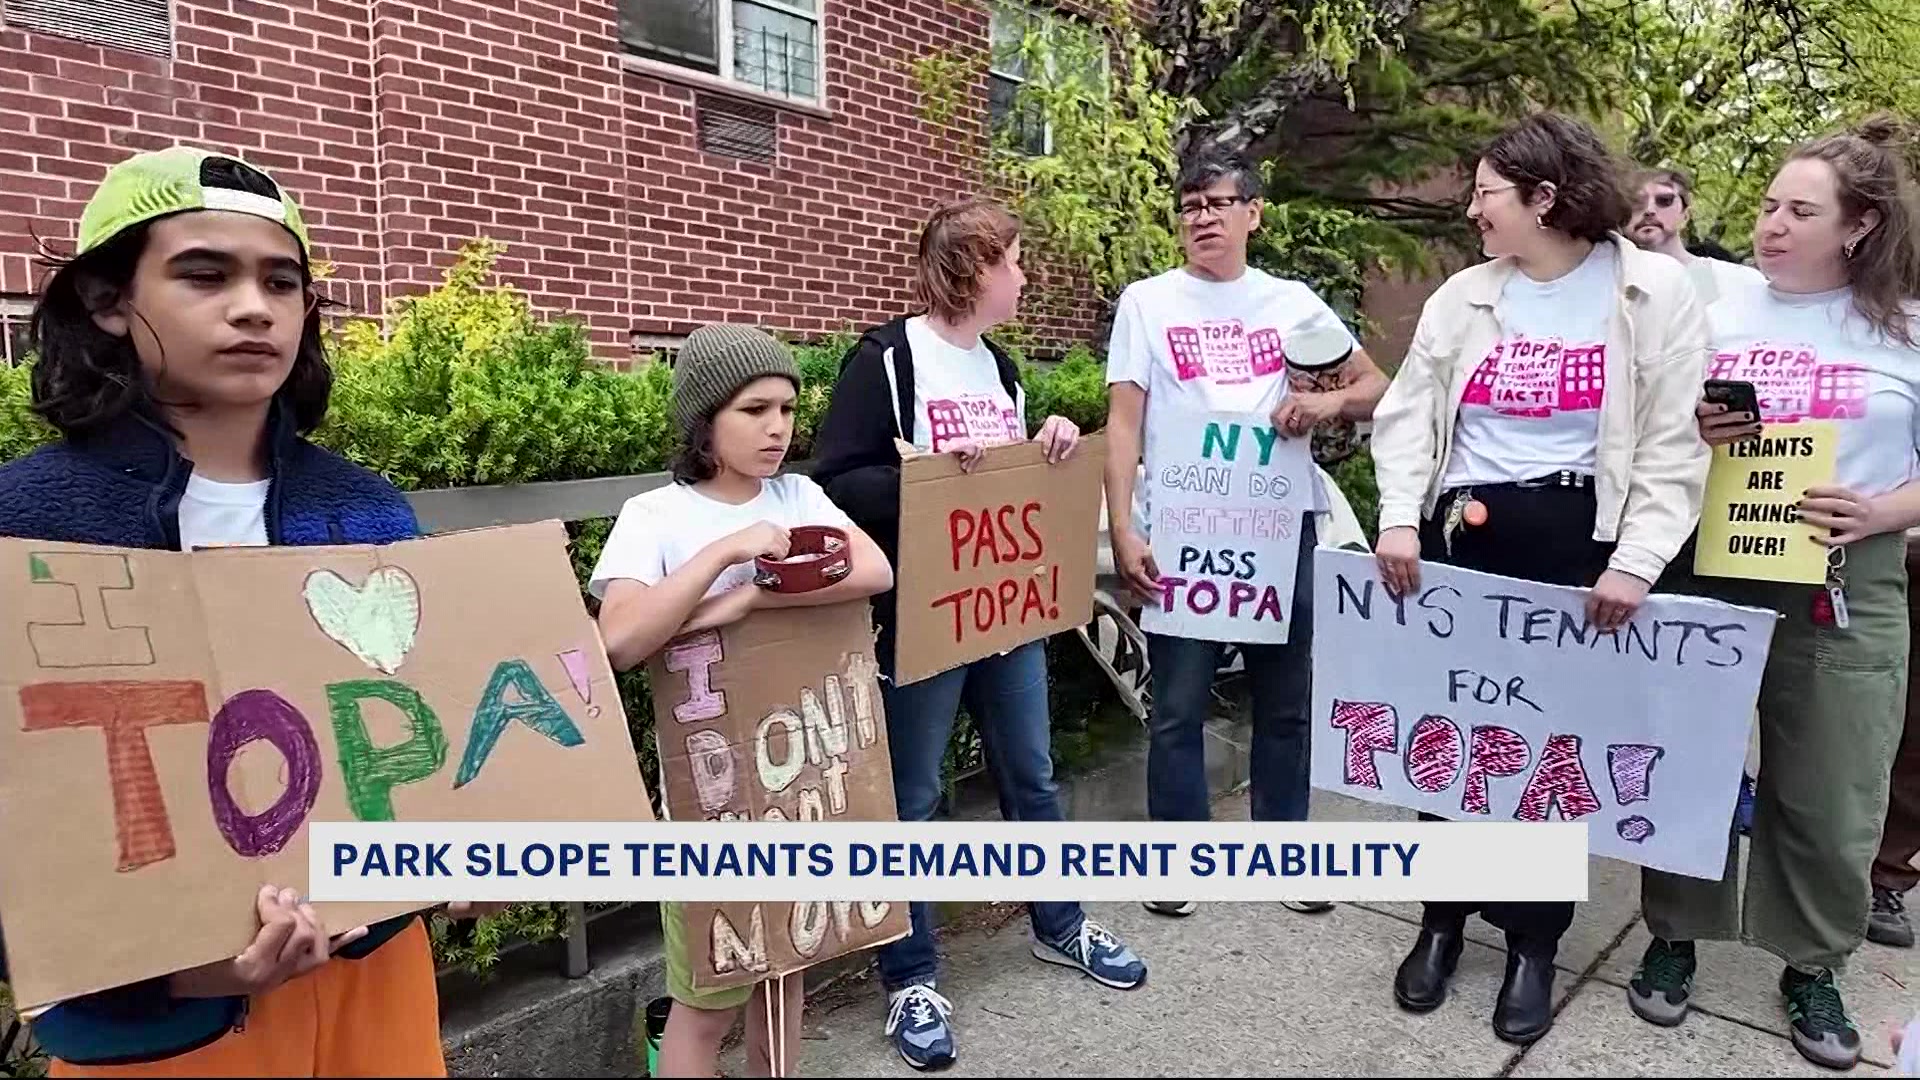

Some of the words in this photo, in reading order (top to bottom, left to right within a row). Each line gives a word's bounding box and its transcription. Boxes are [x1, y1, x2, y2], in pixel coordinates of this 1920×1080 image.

[1203, 324, 1243, 340] TOPA
[1509, 341, 1561, 358] TOPA
[1504, 359, 1556, 373] TENANT
[1750, 349, 1815, 367] TOPA
[961, 399, 998, 417] TOPA
[1202, 423, 1278, 466] NY
[1728, 436, 1814, 458] TENANTS
[1161, 463, 1232, 496] CAN
[1249, 472, 1292, 500] DO
[1746, 470, 1785, 490] ARE
[1160, 507, 1294, 541] BETTER
[1728, 502, 1797, 524] TAKING
[949, 502, 1043, 572] PASS
[1728, 534, 1787, 556] OVER!
[1178, 545, 1257, 580] PASS
[27, 551, 155, 668] I
[931, 565, 1060, 644] TOPA!
[1157, 576, 1284, 623] TOPA
[1335, 573, 1462, 639] NYS
[1483, 594, 1748, 668] TENANTS
[664, 628, 729, 724] I
[1448, 669, 1544, 713] FOR
[18, 649, 602, 873] TOPA!
[1330, 698, 1666, 845] TOPA!
